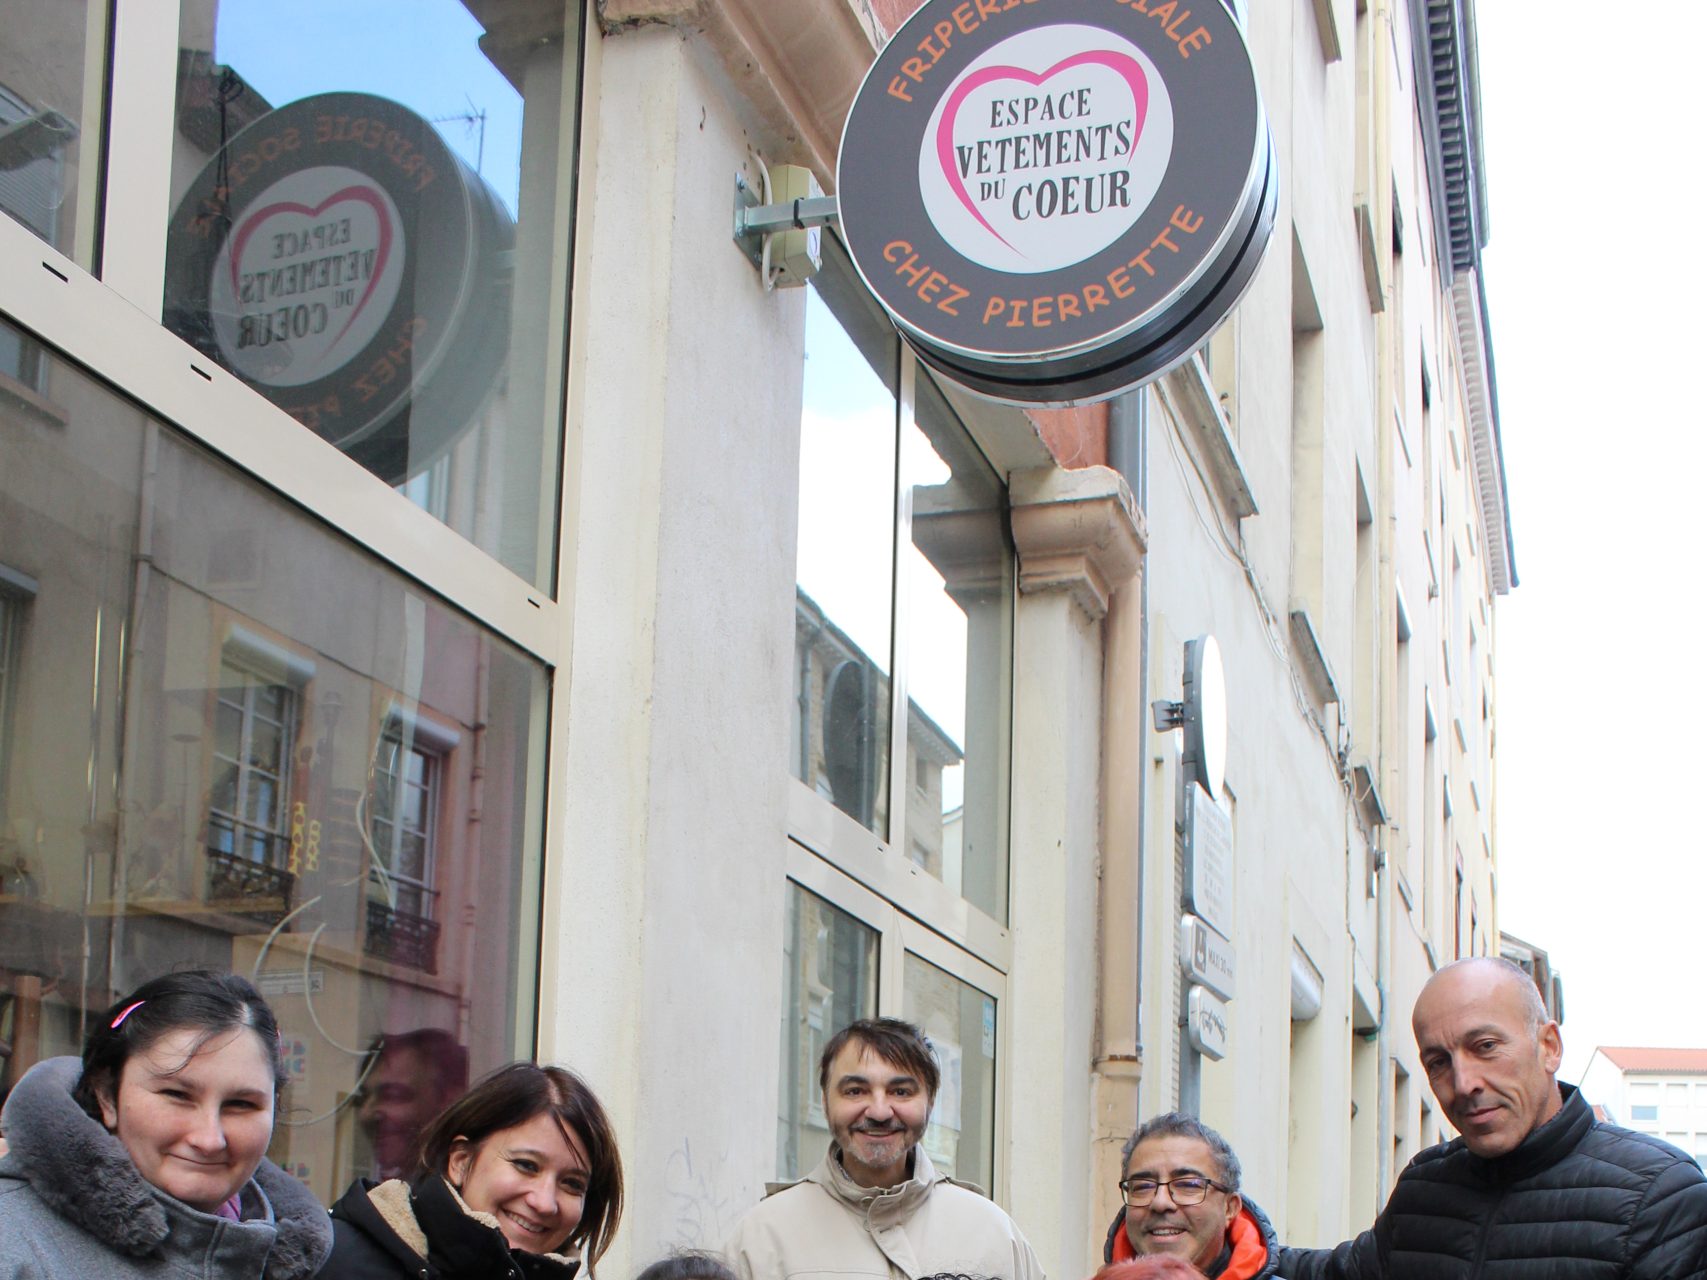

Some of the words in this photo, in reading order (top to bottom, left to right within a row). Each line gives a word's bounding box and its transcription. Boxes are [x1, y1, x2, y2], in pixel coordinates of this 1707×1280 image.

[888, 0, 1039, 102] FRIPER
[990, 88, 1091, 128] ESPACE
[956, 119, 1131, 179] VETEMENTS
[980, 178, 1006, 201] DU
[1012, 170, 1131, 220] COEUR
[883, 240, 971, 317] CHEZ
[983, 204, 1204, 328] PIERRETTE
